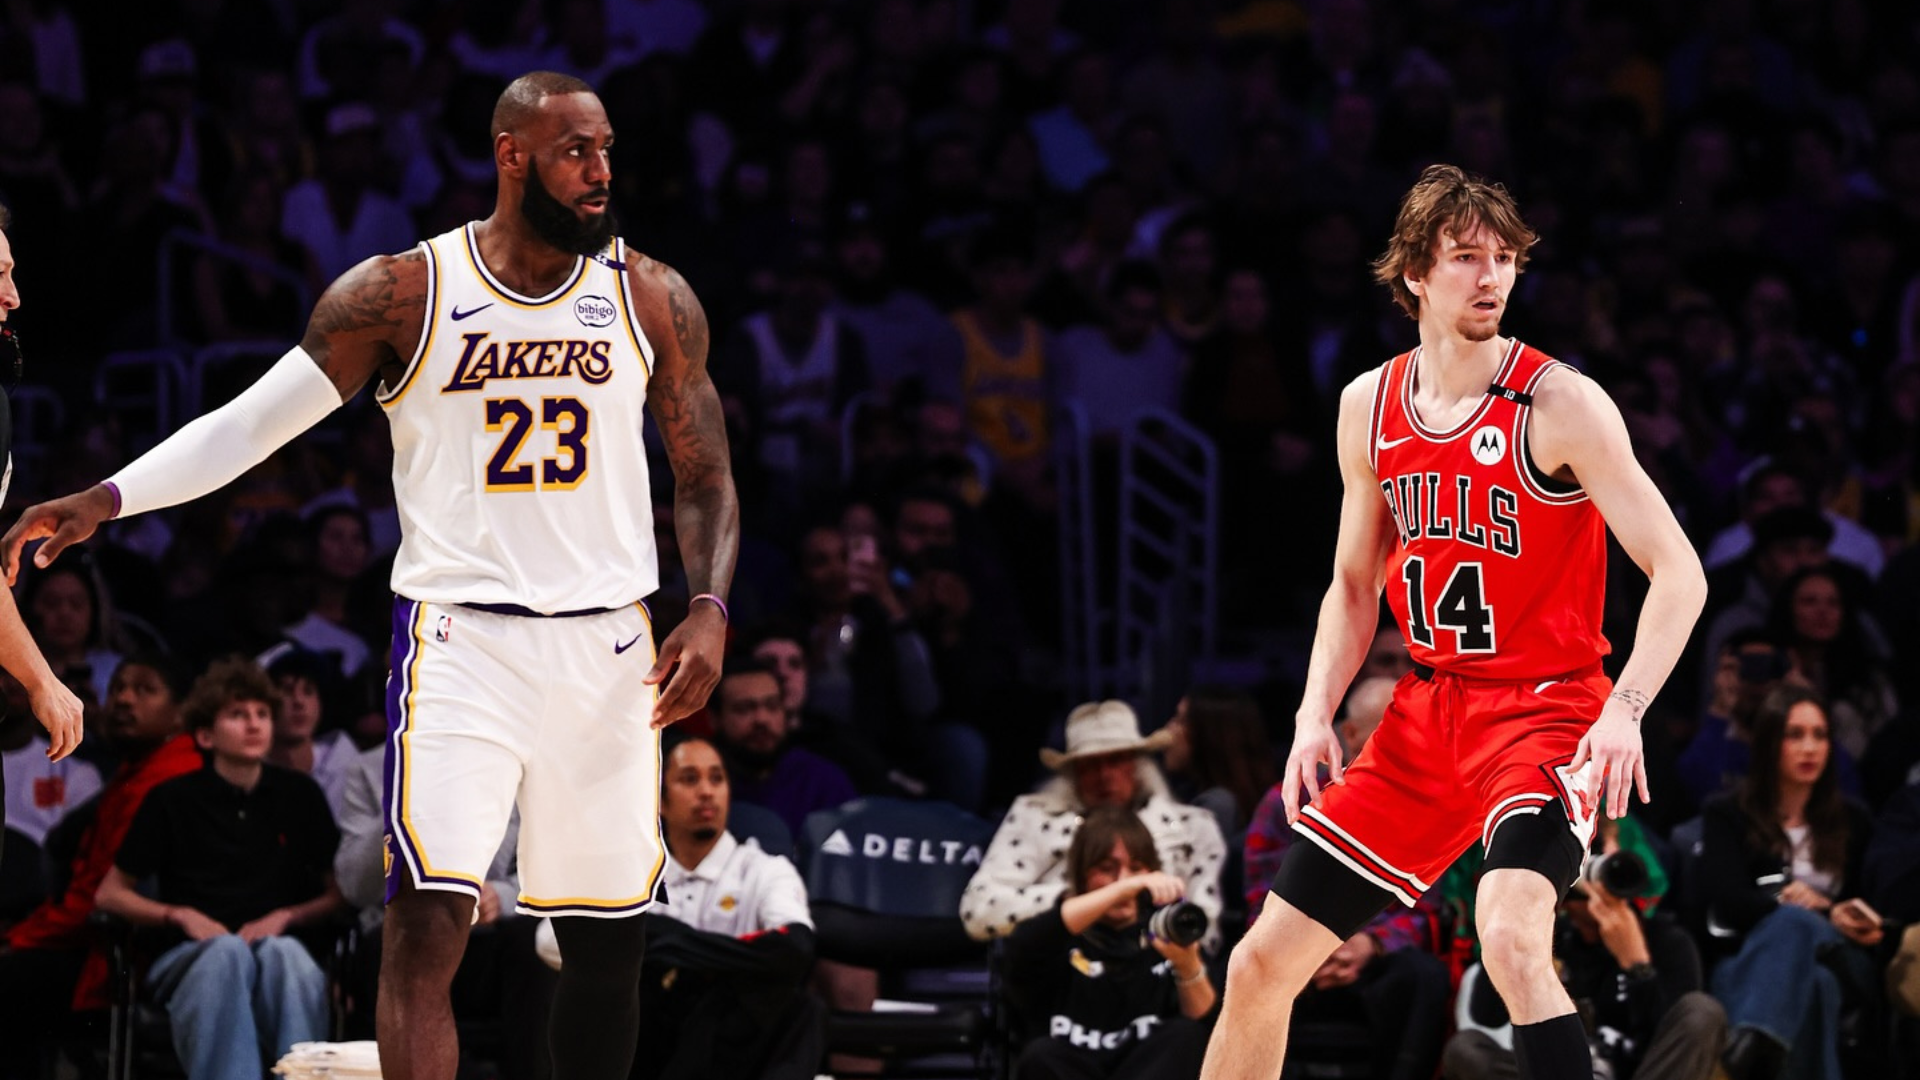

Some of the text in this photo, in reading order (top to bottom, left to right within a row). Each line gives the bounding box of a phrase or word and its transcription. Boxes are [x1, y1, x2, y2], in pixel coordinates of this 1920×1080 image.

[578, 303, 613, 319] bibigo
[440, 332, 612, 394] LAKERS
[1503, 388, 1516, 401] 10
[484, 395, 589, 493] 23
[1402, 555, 1497, 654] 14
[862, 832, 983, 865] DELTA
